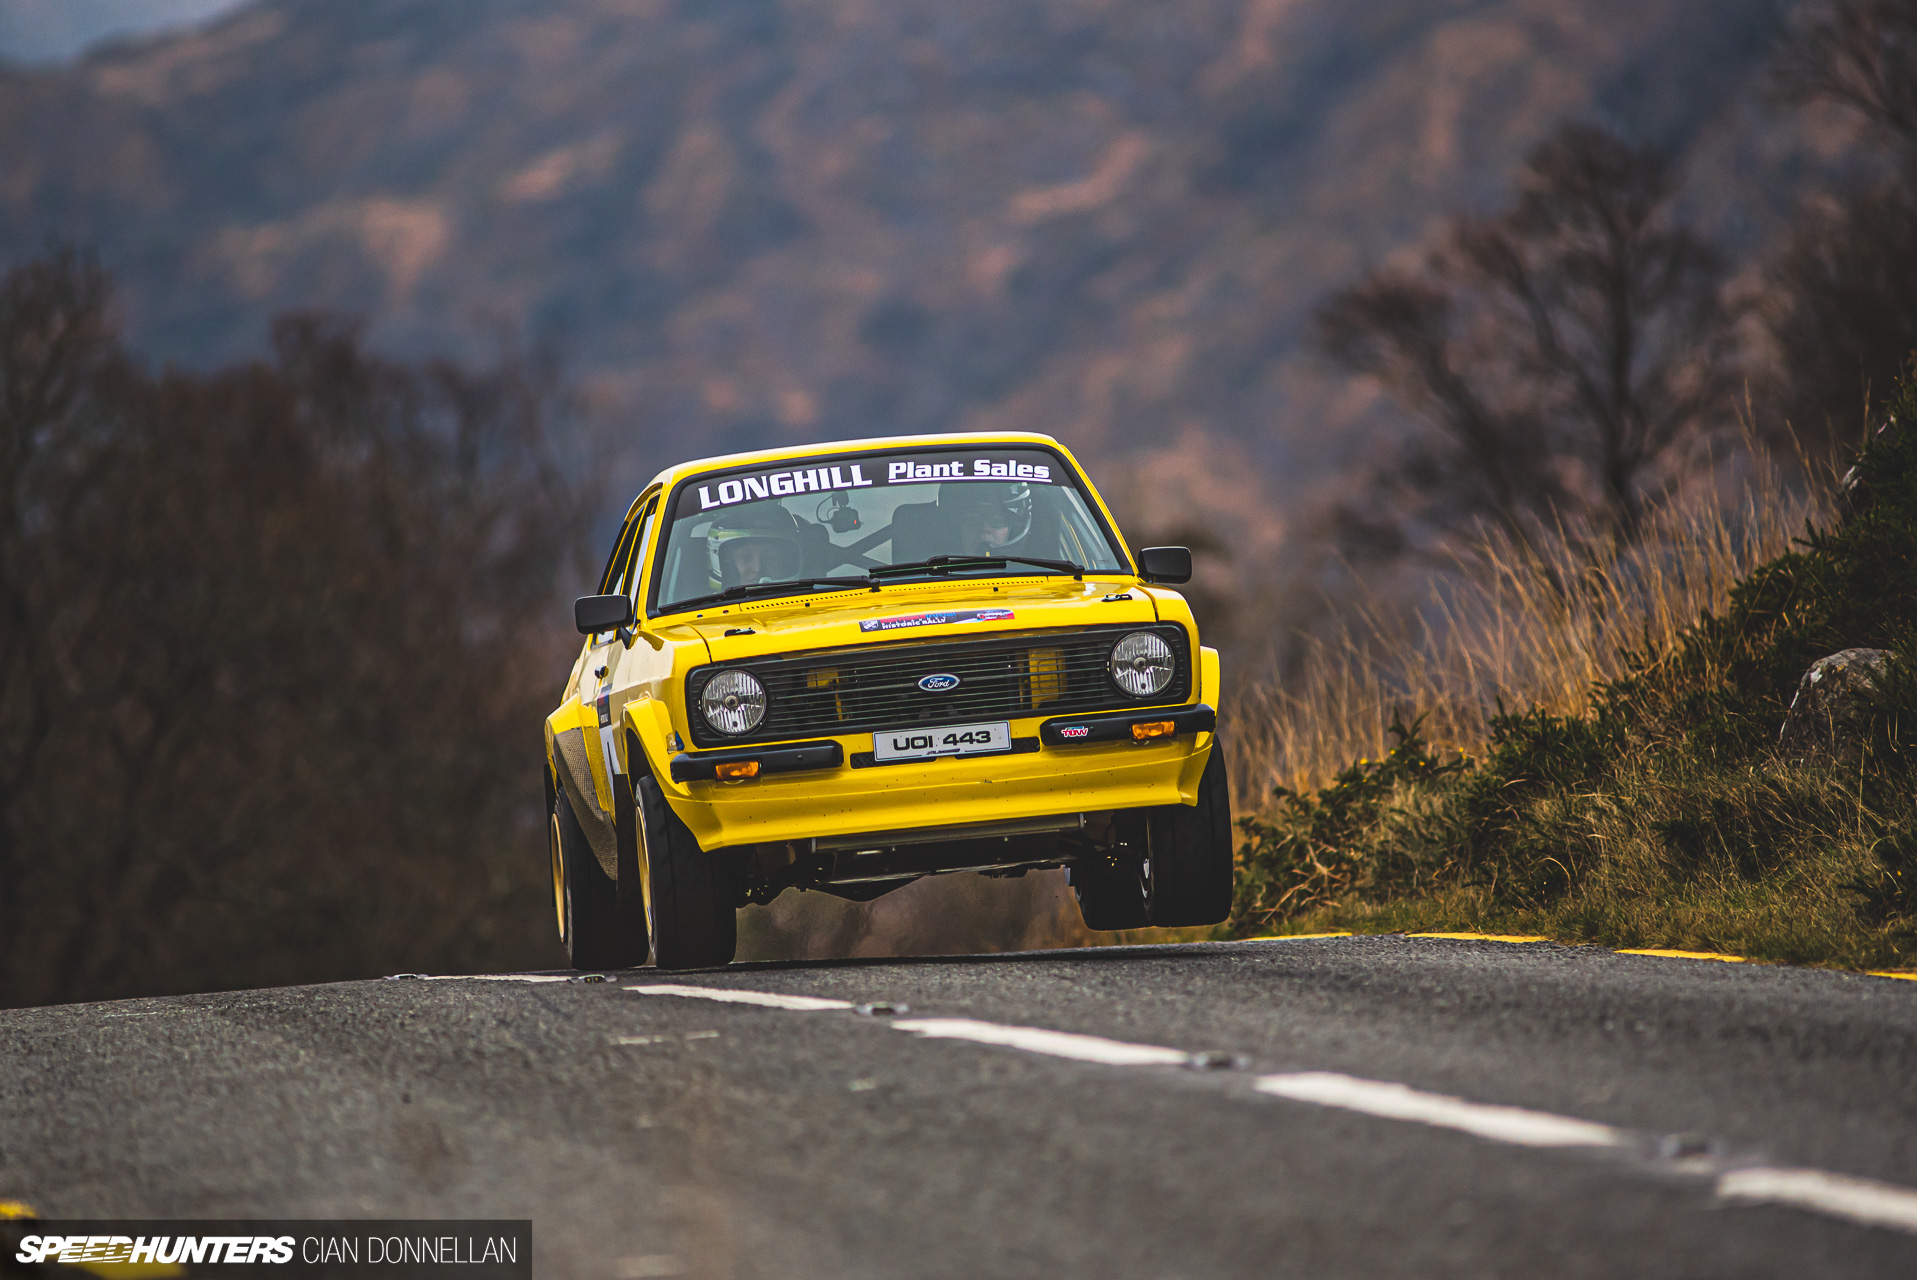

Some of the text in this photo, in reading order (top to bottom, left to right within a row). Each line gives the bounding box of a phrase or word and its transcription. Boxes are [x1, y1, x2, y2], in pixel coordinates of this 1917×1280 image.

[698, 459, 1050, 510] LONGHILL Plant Sales
[927, 677, 950, 689] Ford
[893, 730, 991, 751] UOI 443
